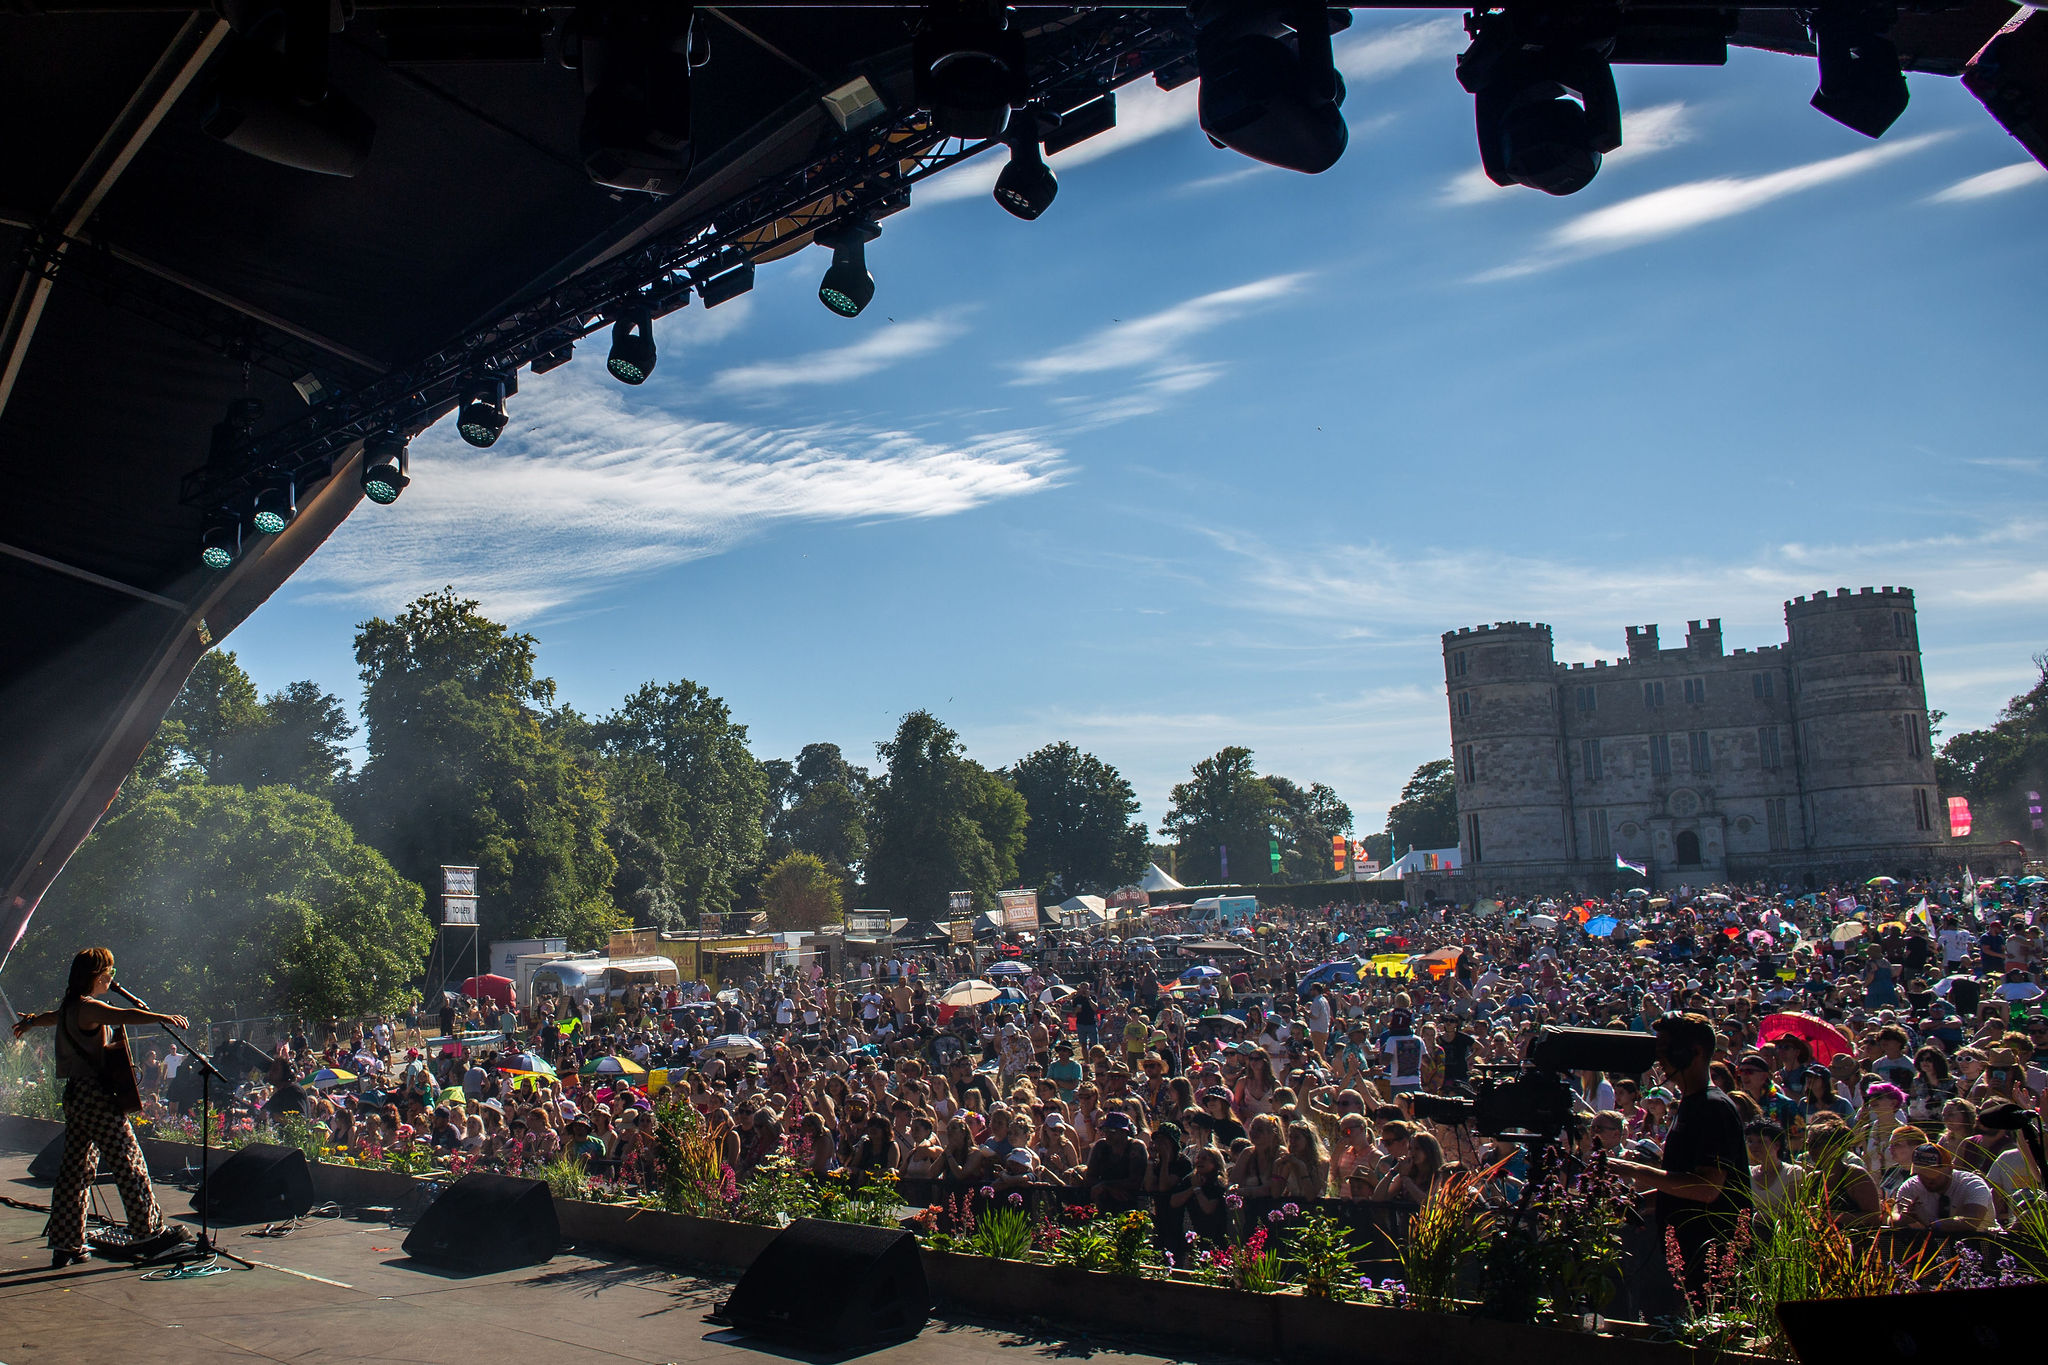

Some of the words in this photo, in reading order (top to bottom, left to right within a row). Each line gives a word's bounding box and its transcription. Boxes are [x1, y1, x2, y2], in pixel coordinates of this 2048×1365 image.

[1116, 892, 1127, 900] PASTA
[1129, 891, 1140, 900] PIZZA
[452, 906, 470, 914] TOILETS
